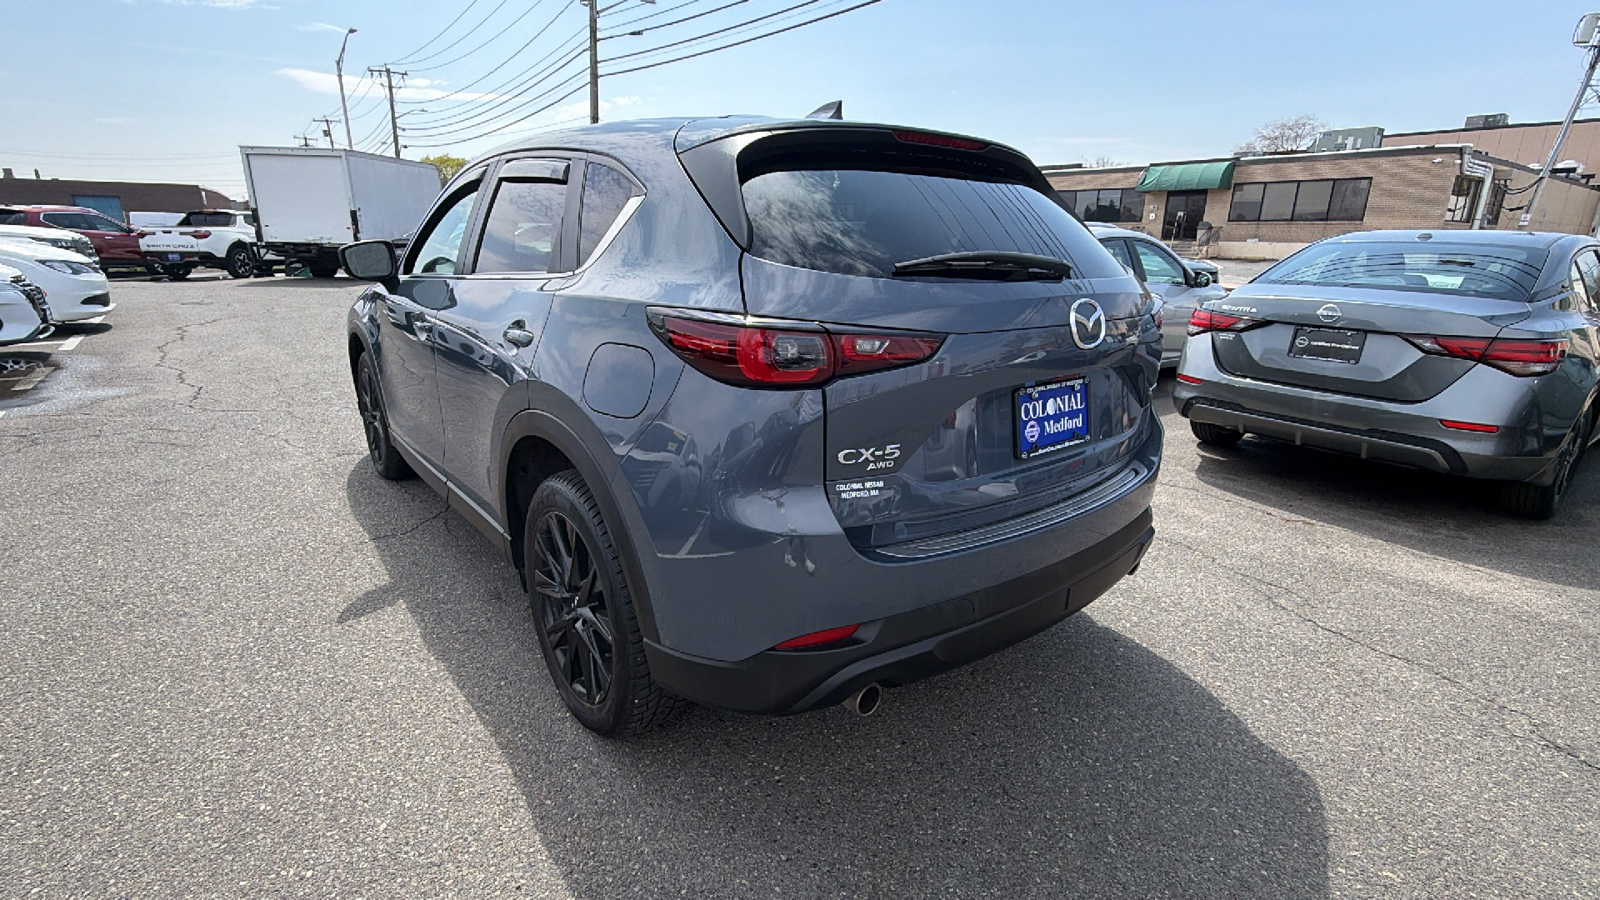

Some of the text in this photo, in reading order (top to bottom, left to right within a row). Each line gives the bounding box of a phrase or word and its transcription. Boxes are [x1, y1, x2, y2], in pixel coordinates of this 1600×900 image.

[1221, 304, 1257, 313] SENTRA
[1021, 393, 1085, 421] COLONIAL
[1044, 413, 1083, 436] Medford
[838, 444, 900, 464] CX-5
[866, 460, 894, 471] AWD
